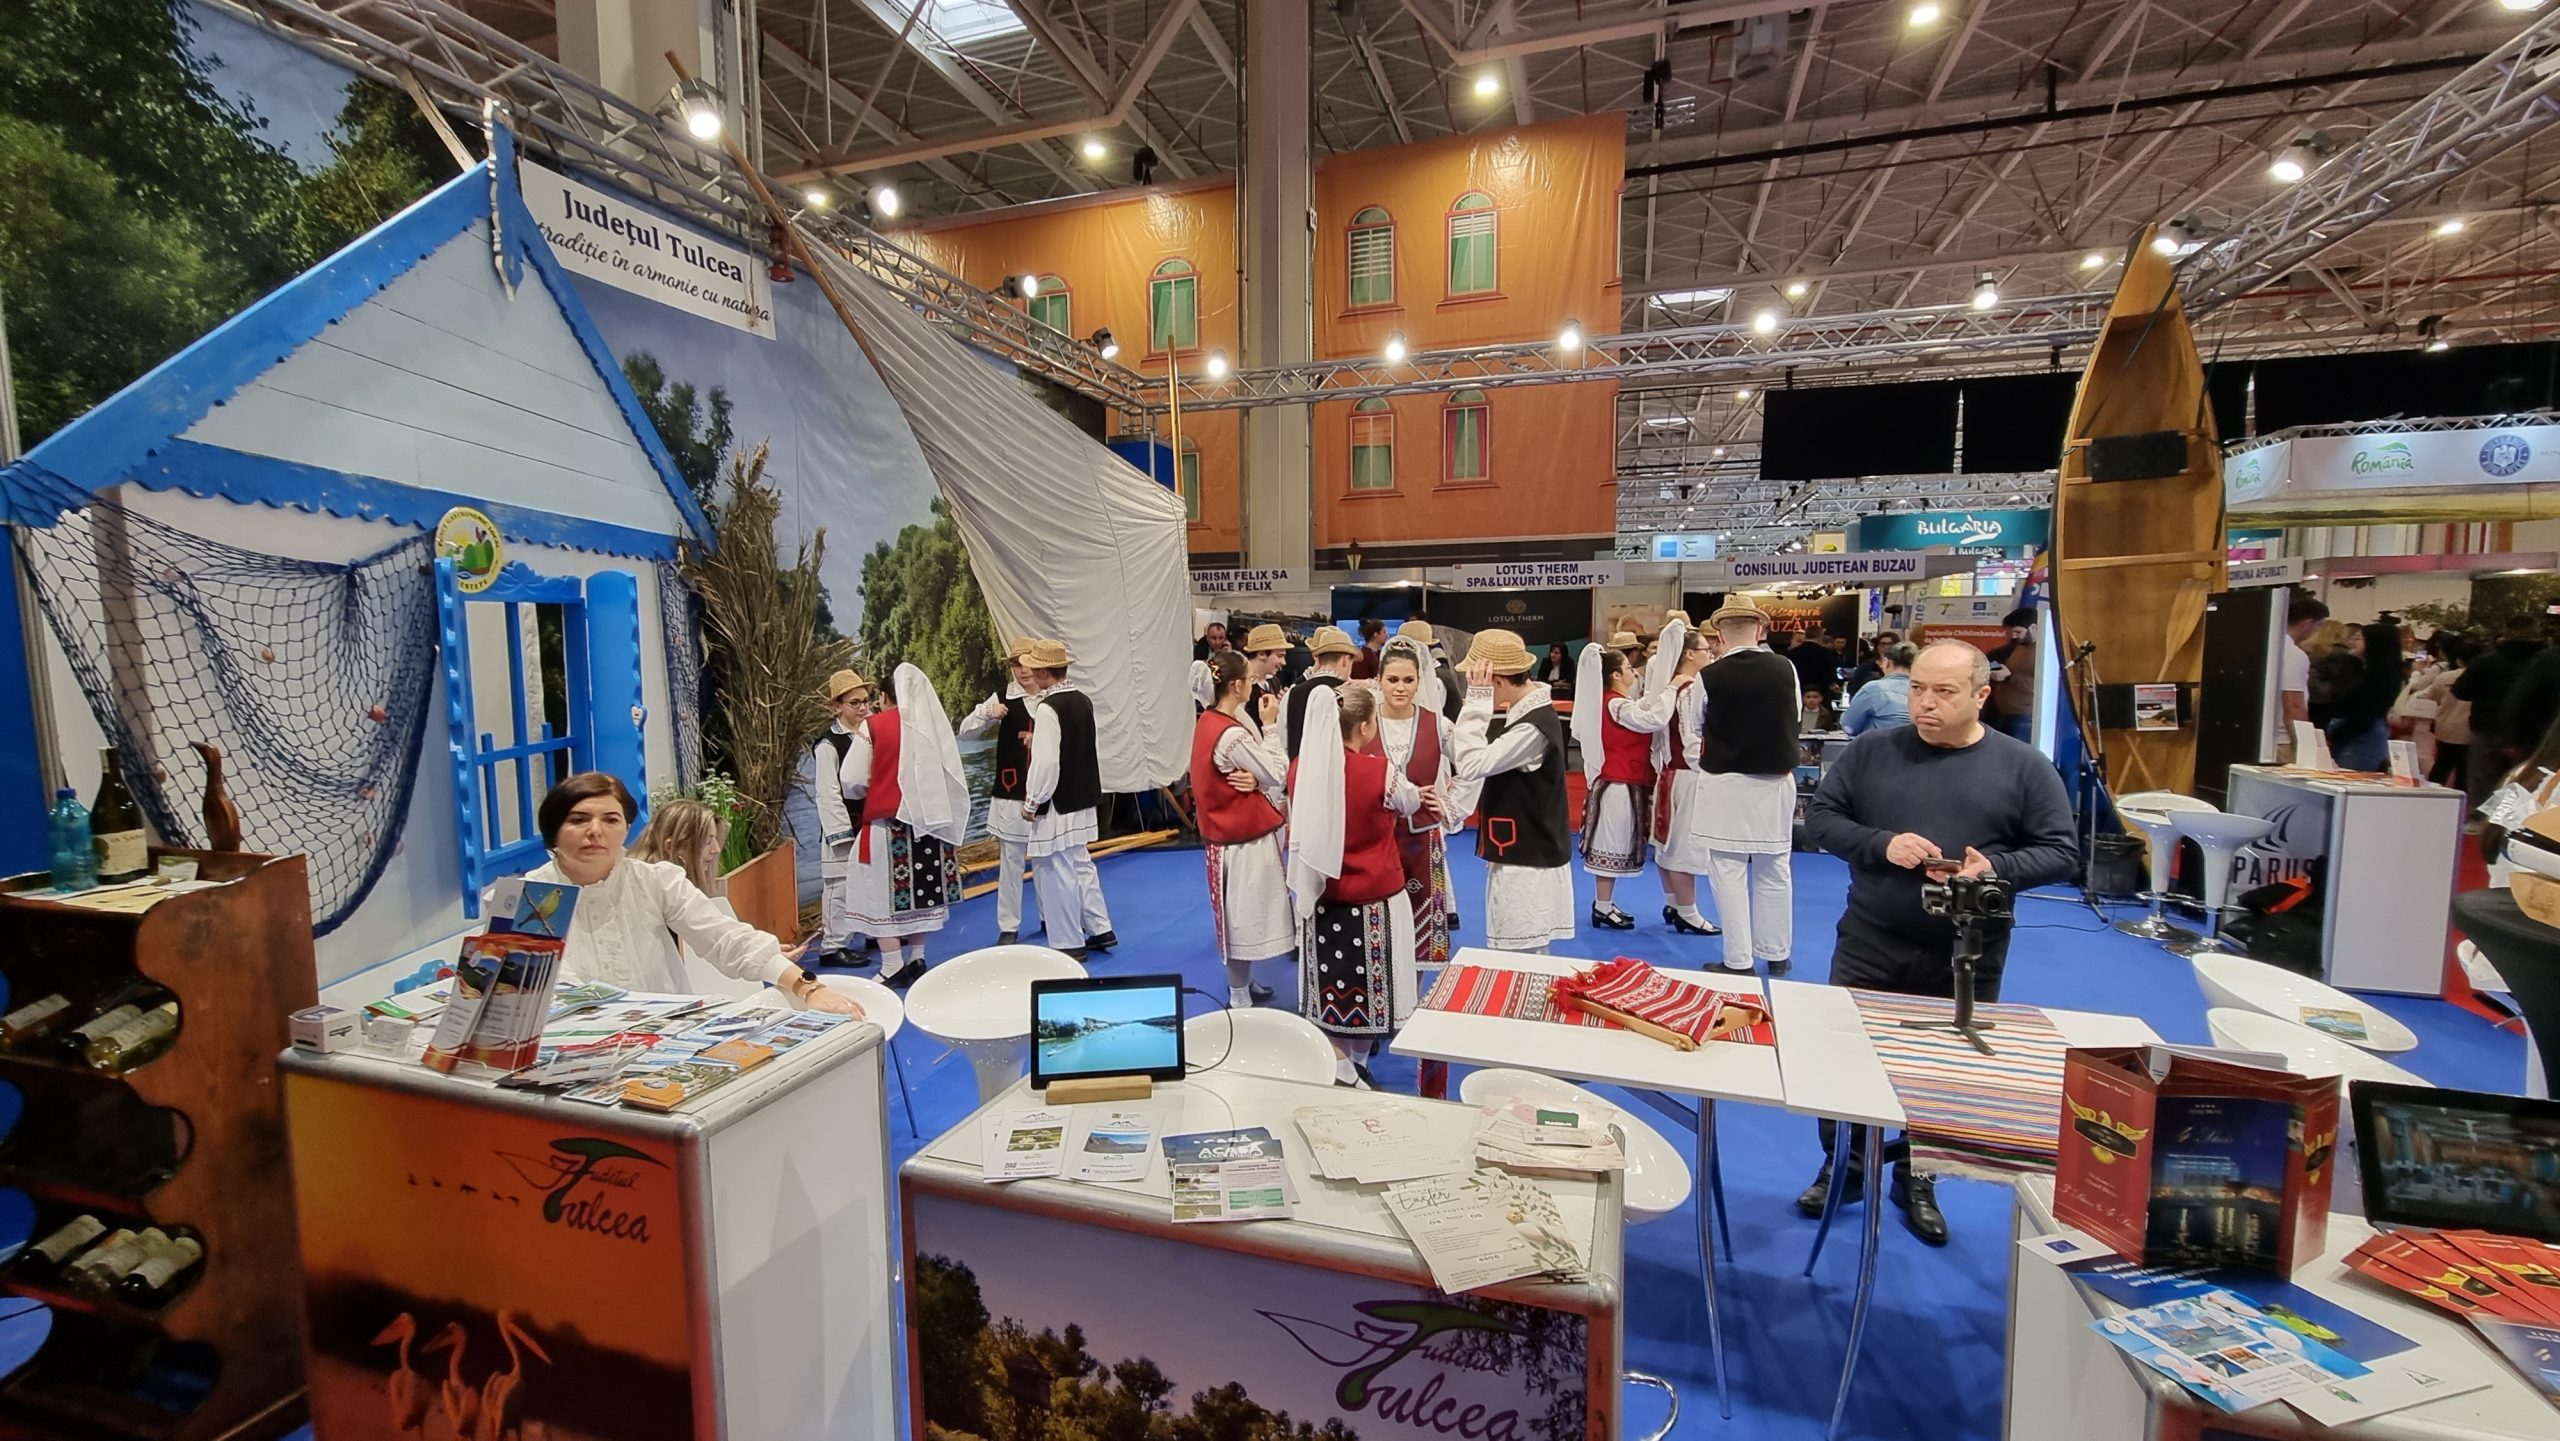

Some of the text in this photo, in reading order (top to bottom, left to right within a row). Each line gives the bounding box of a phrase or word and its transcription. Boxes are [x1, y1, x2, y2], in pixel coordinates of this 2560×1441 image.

[563, 189, 743, 283] Județul Tulcea
[538, 222, 770, 321] tradiție în armonie cu natura
[2352, 451, 2415, 475] România
[1917, 515, 2002, 541] BULGARIA
[1190, 570, 1288, 582] URISM FELIX SA
[1496, 563, 1579, 575] LOTUS THERM
[1734, 559, 1916, 576] CONSILIUL JUDETEAN BUZAU
[1200, 581, 1272, 592] BAILE FELIX
[1466, 576, 1543, 588] SPA&LUXURY
[1547, 575, 1594, 586] RESORT
